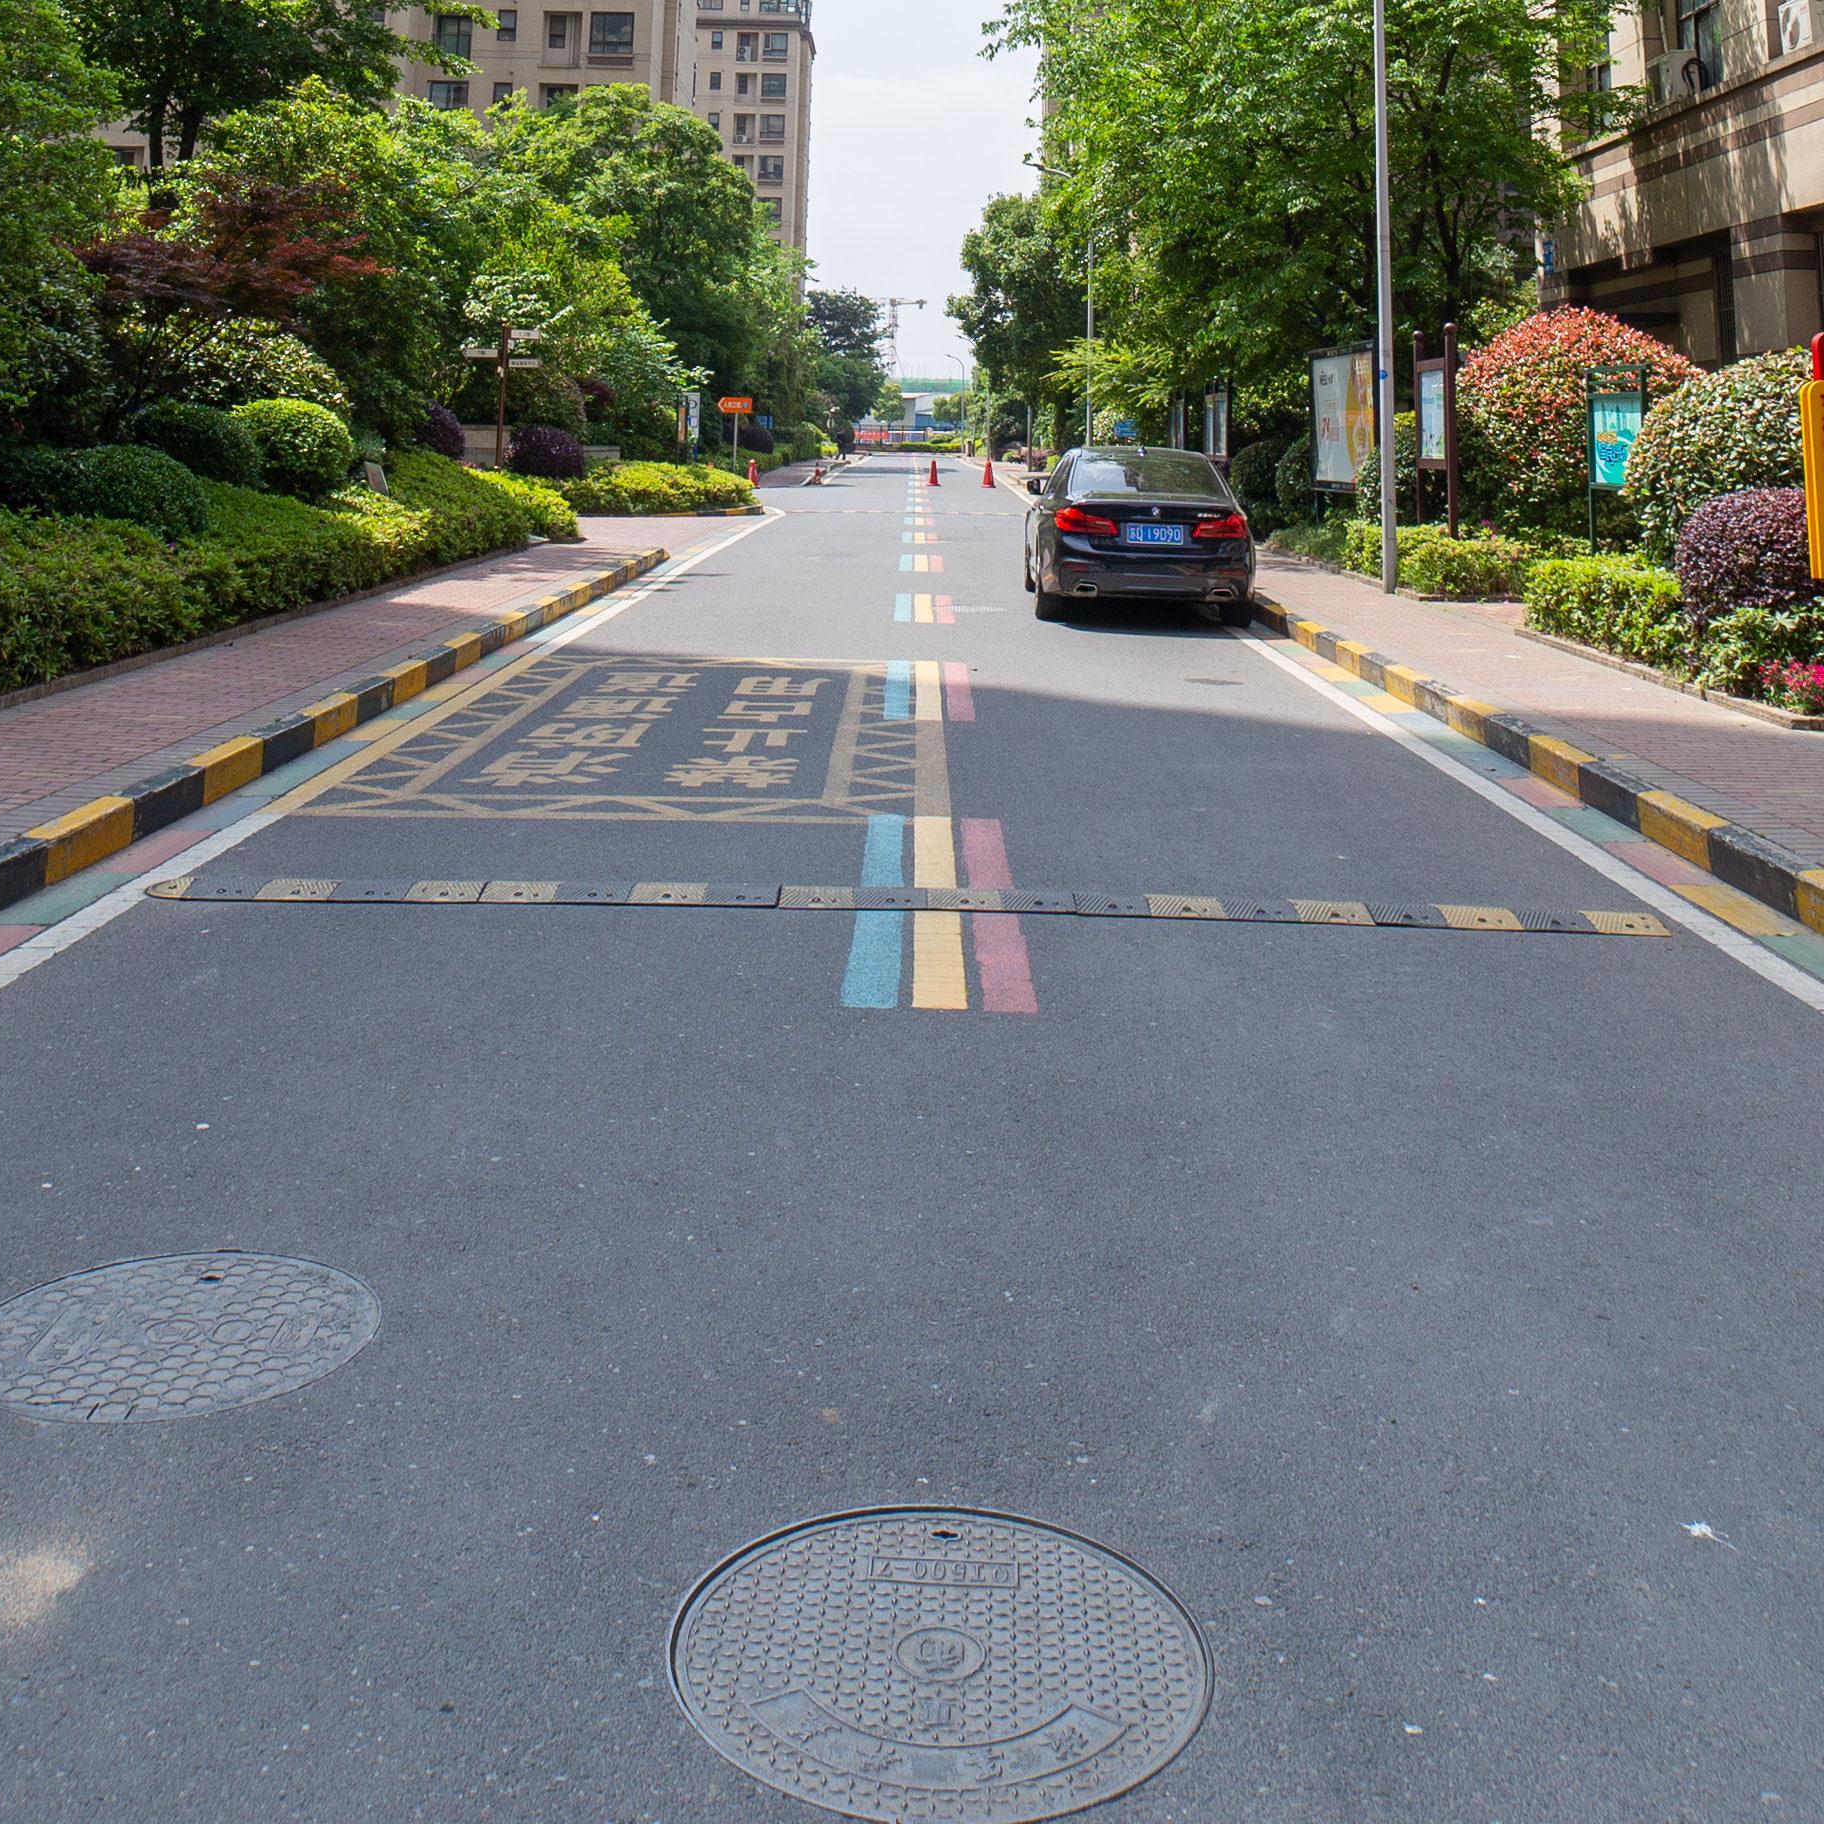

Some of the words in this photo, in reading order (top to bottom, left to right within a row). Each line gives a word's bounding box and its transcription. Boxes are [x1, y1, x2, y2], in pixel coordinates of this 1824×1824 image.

[459, 672, 703, 787] 消防通道
[663, 676, 830, 789] 禁止占用
